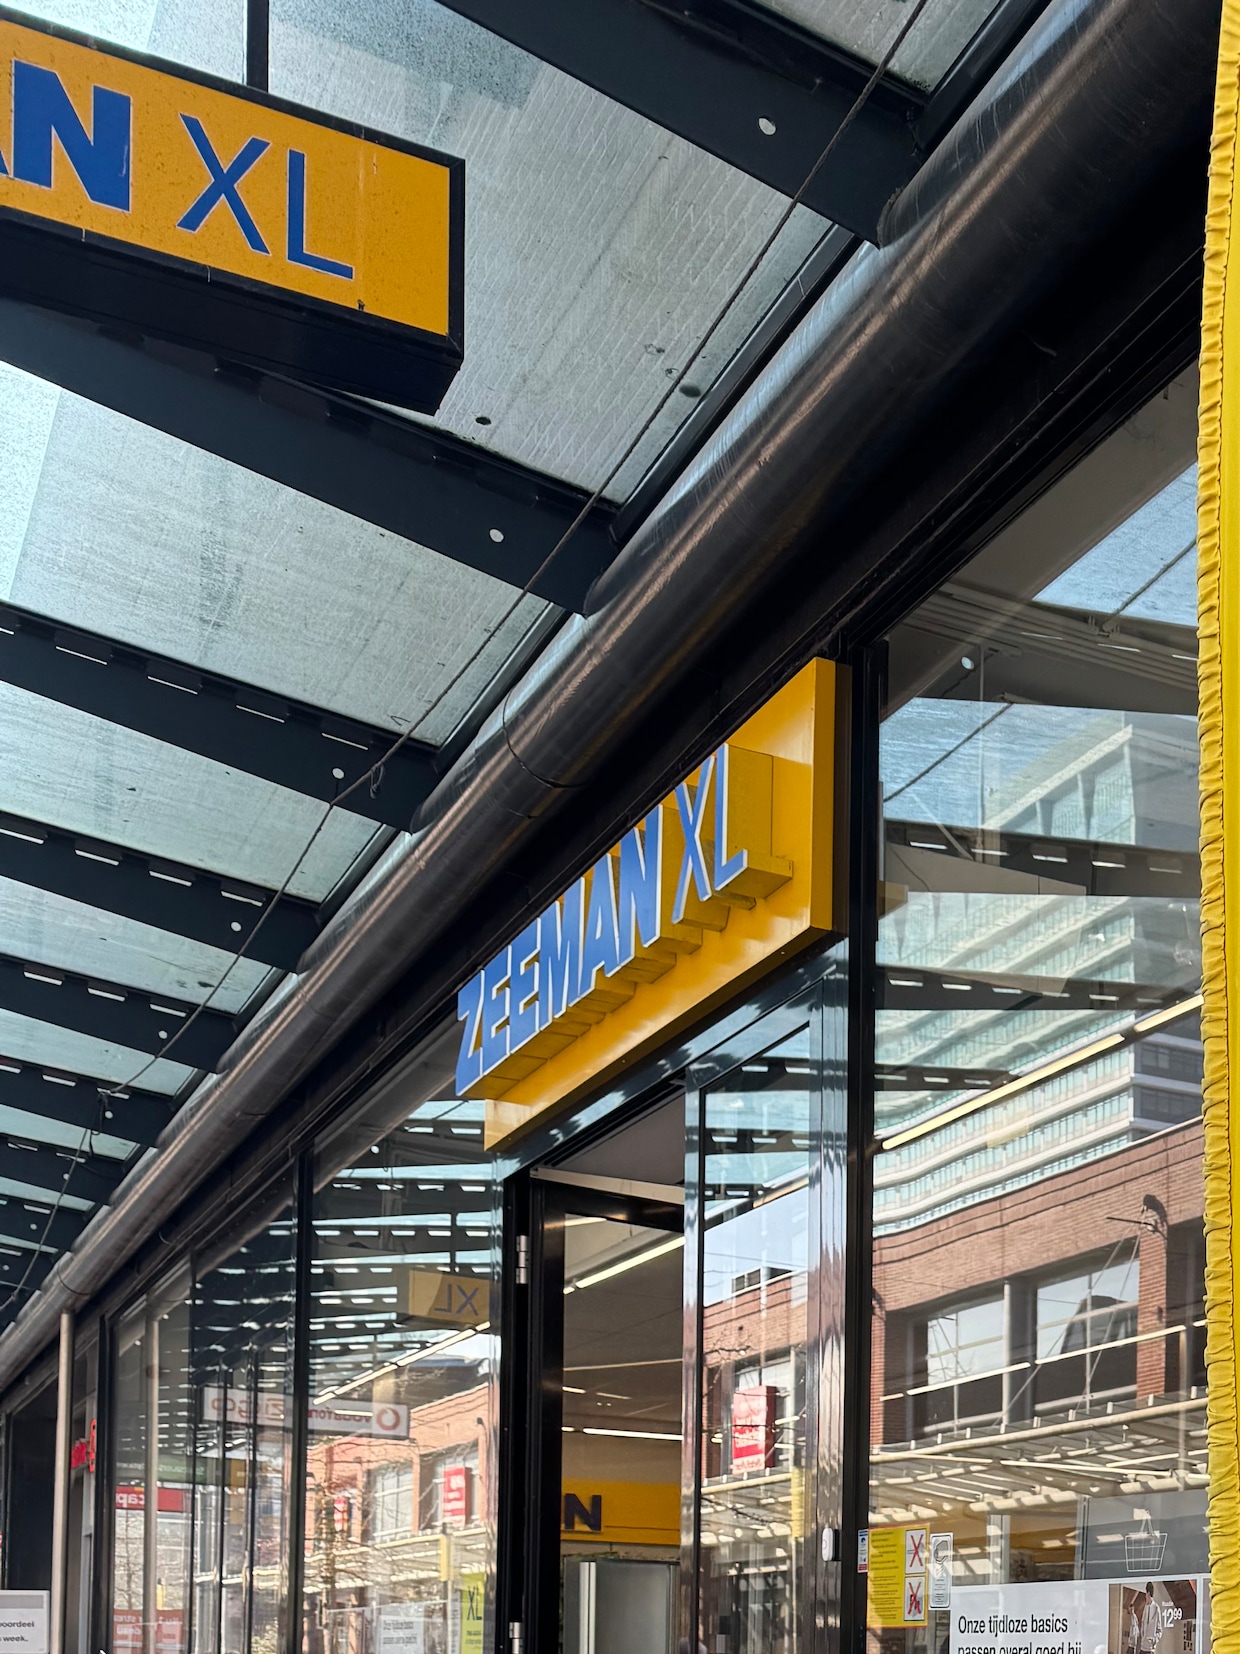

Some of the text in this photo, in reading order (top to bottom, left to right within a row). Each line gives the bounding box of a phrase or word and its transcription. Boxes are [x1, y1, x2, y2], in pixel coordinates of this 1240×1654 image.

[0, 60, 354, 281] N XL
[456, 743, 748, 1097] ZEEMAN XL
[958, 1613, 1068, 1638] Onze tijdloze basics
